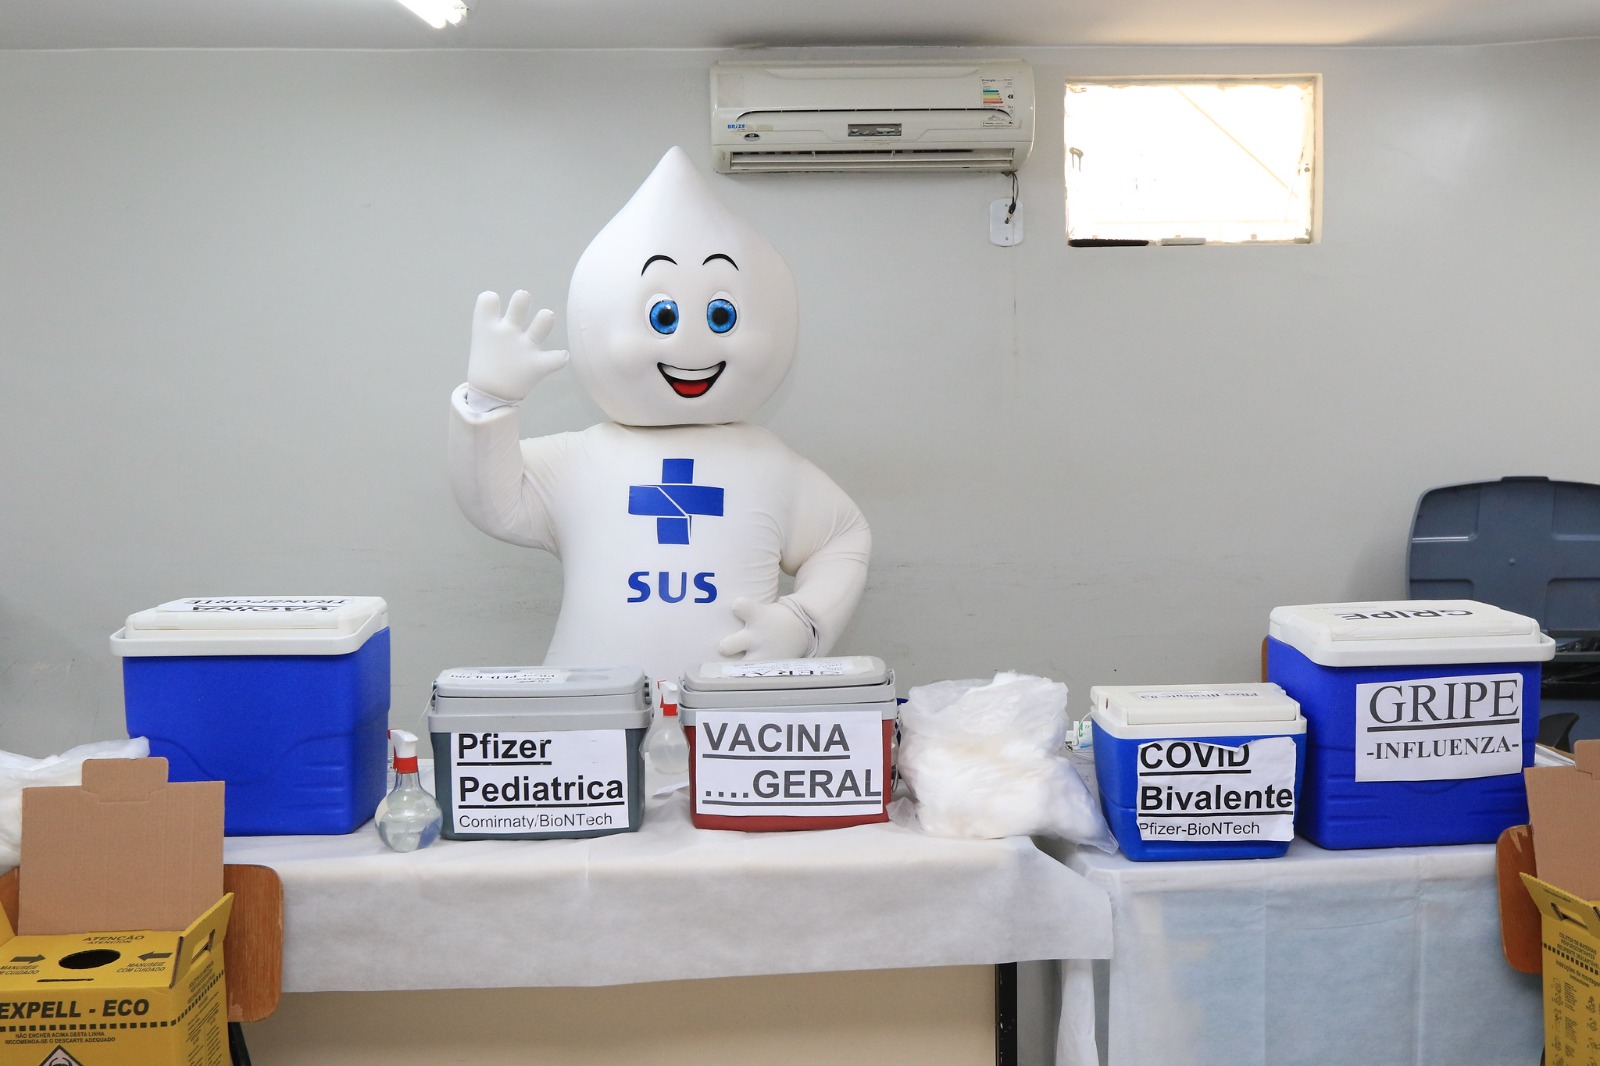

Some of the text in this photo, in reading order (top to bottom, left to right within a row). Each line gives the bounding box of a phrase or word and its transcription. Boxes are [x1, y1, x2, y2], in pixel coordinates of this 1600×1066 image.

[627, 571, 717, 604] SUS
[1335, 609, 1473, 620] GRIPE
[1369, 679, 1519, 724] GRIPE
[458, 733, 552, 759] Pfizer
[703, 722, 850, 753] VACINA
[1366, 736, 1519, 760] -INFLUENZA-
[1140, 742, 1250, 769] COVID
[459, 775, 623, 802] Pediatrica
[1140, 784, 1293, 811] Bivalente
[459, 813, 612, 829] Comirnaty/BioNTech
[1139, 822, 1260, 836] Pfizer-BioNTech
[0, 1000, 81, 1019] EXPELL
[102, 999, 150, 1017] ECO
